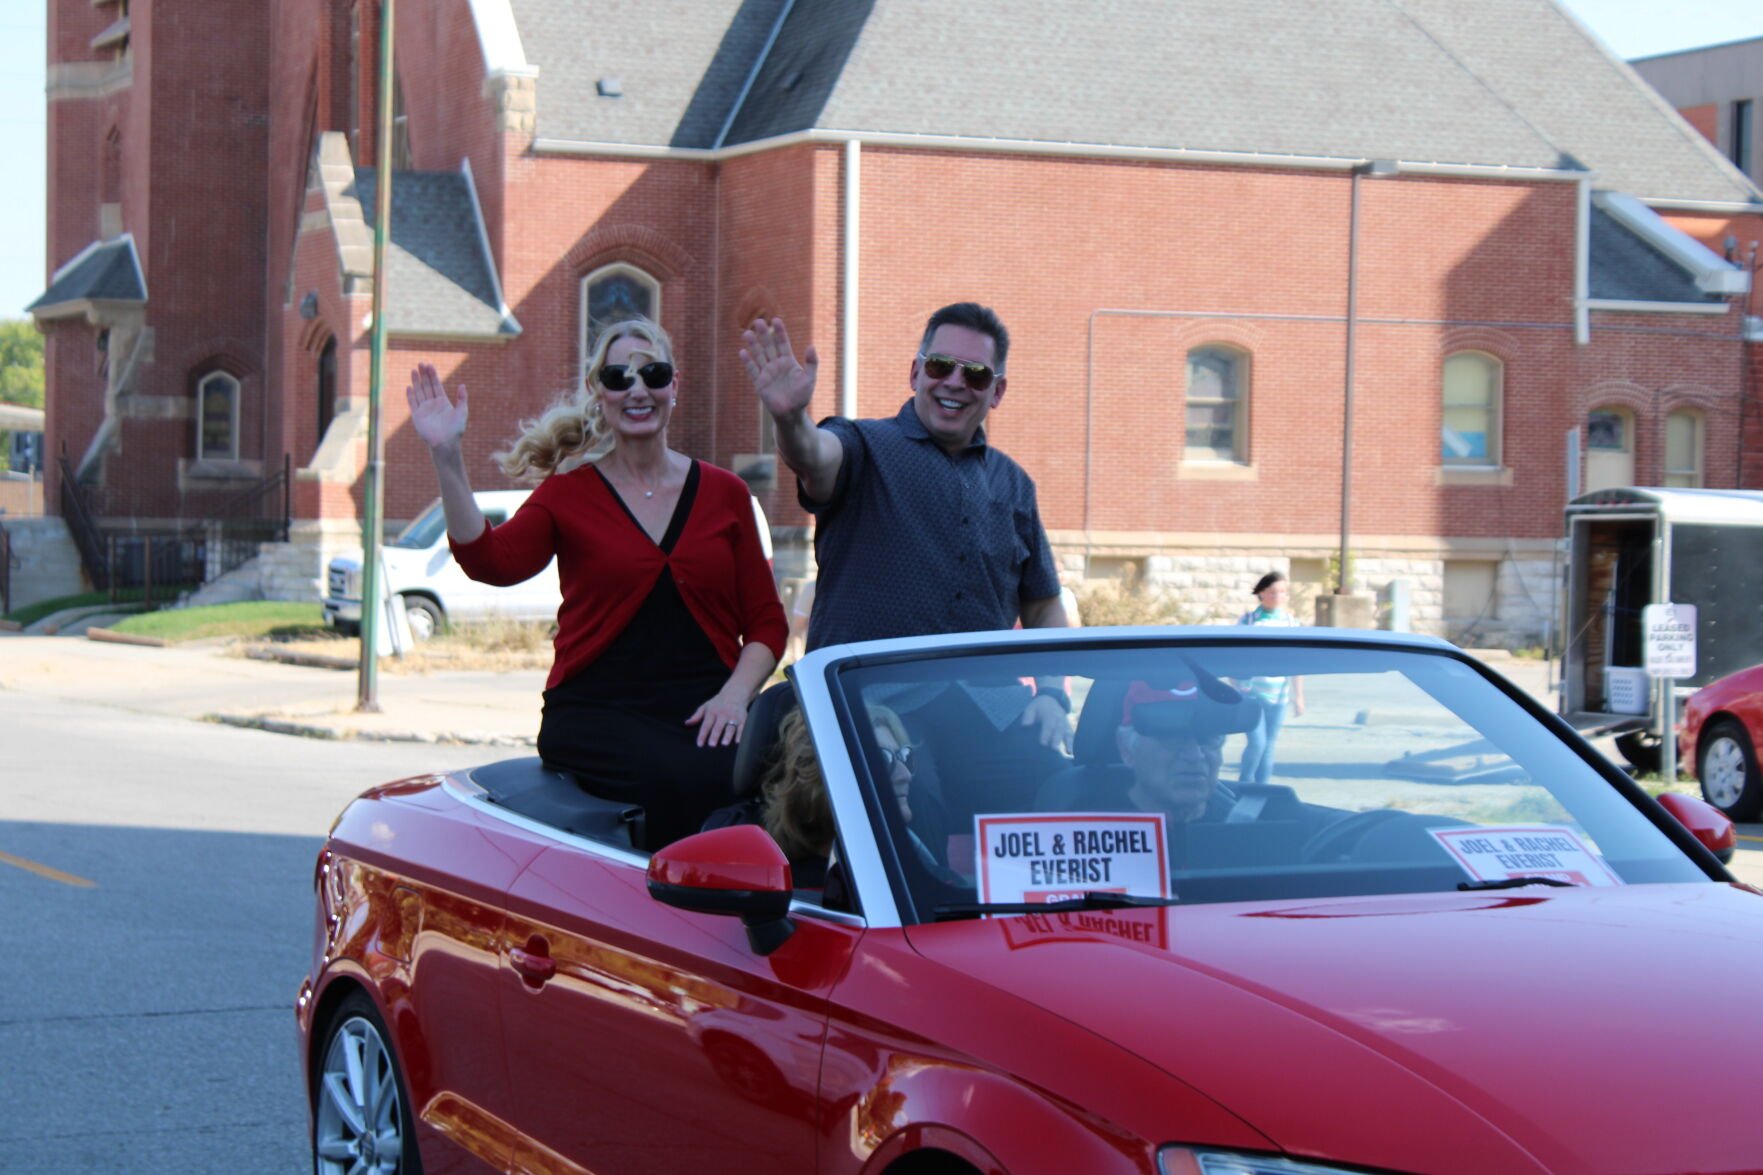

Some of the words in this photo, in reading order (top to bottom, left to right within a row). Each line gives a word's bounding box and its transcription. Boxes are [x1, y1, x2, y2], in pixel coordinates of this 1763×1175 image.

[1652, 623, 1690, 632] LEASED
[1650, 633, 1693, 642] PARKING
[1657, 642, 1684, 651] ONLY
[994, 832, 1045, 858] JOEL
[1052, 833, 1066, 856] &
[1072, 830, 1153, 855] RACHEL
[1459, 838, 1499, 855] JOEL
[1501, 839, 1515, 851] &
[1516, 836, 1579, 852] RACHEL
[1496, 853, 1564, 869] EVERIST
[1030, 857, 1112, 885] EVERIST
